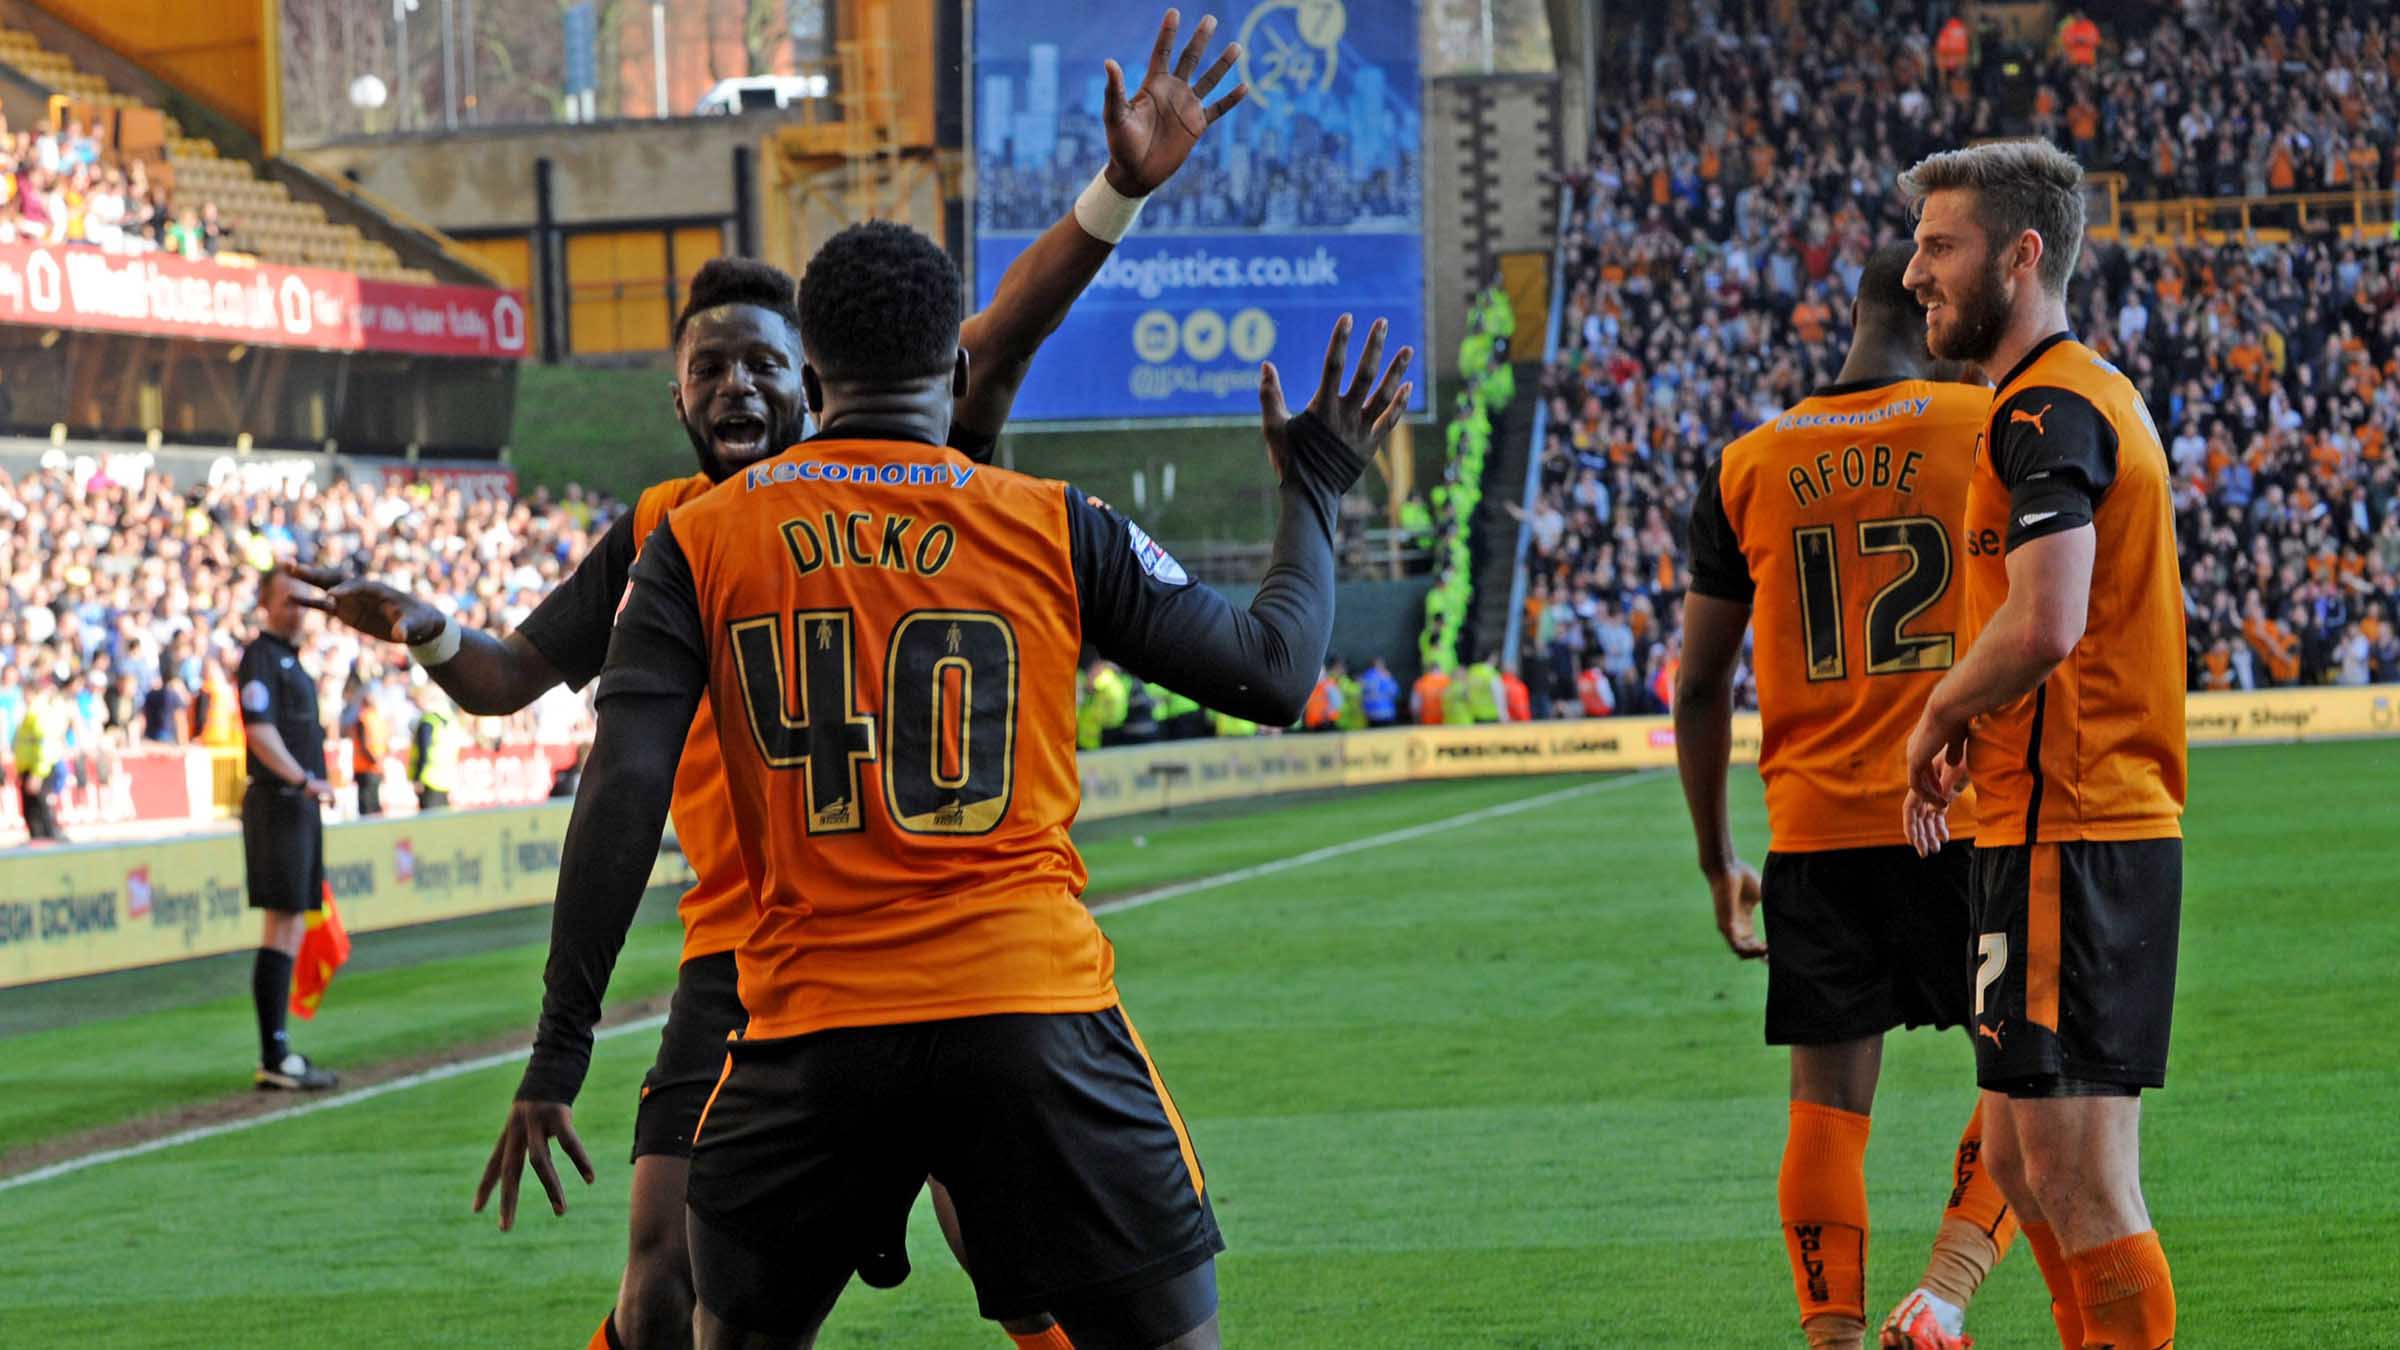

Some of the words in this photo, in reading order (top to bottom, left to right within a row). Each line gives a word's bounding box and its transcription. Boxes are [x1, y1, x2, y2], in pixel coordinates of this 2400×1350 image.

[1775, 395, 1933, 432] Reconomy
[746, 460, 976, 492] Reconomy
[1788, 443, 1924, 509] AFOBE
[778, 511, 957, 579] DICKO
[1793, 514, 1956, 684] 12
[727, 608, 1020, 836] 40
[1975, 932, 2008, 1016] 7
